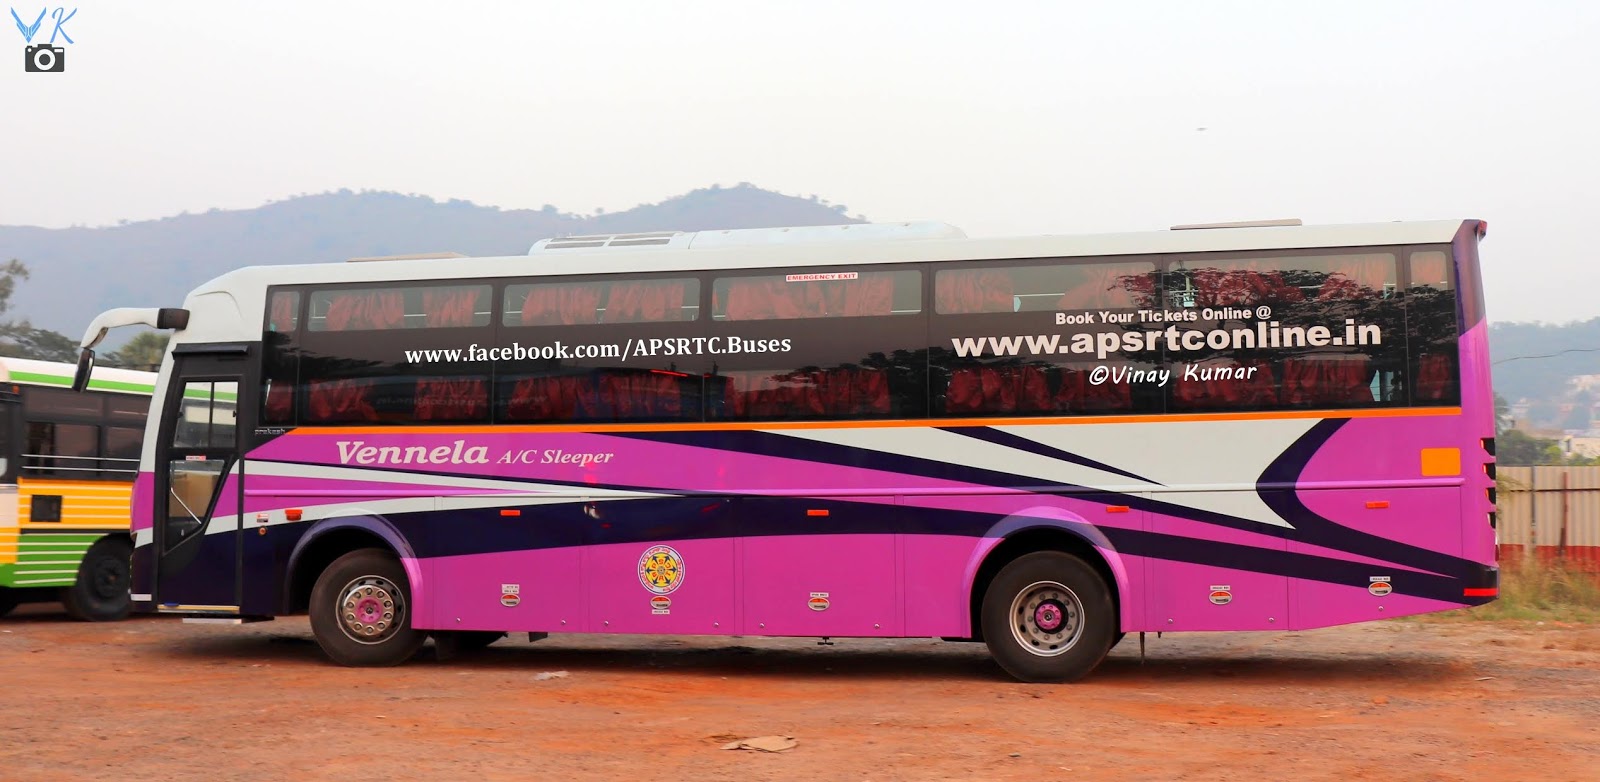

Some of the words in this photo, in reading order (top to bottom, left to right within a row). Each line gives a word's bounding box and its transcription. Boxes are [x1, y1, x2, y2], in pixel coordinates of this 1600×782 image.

[1055, 312, 1095, 325] Book
[1099, 311, 1134, 323] Your
[1138, 308, 1198, 323] Tickets
[1201, 307, 1252, 320] Online
[1256, 305, 1272, 320] @
[404, 336, 792, 364] www.facebook.com/APSRTC.Buses
[951, 318, 1382, 359] www.apsrtconline.in
[336, 439, 490, 465] Vennela
[497, 449, 538, 465] A/C
[540, 449, 614, 468] Sleeper
